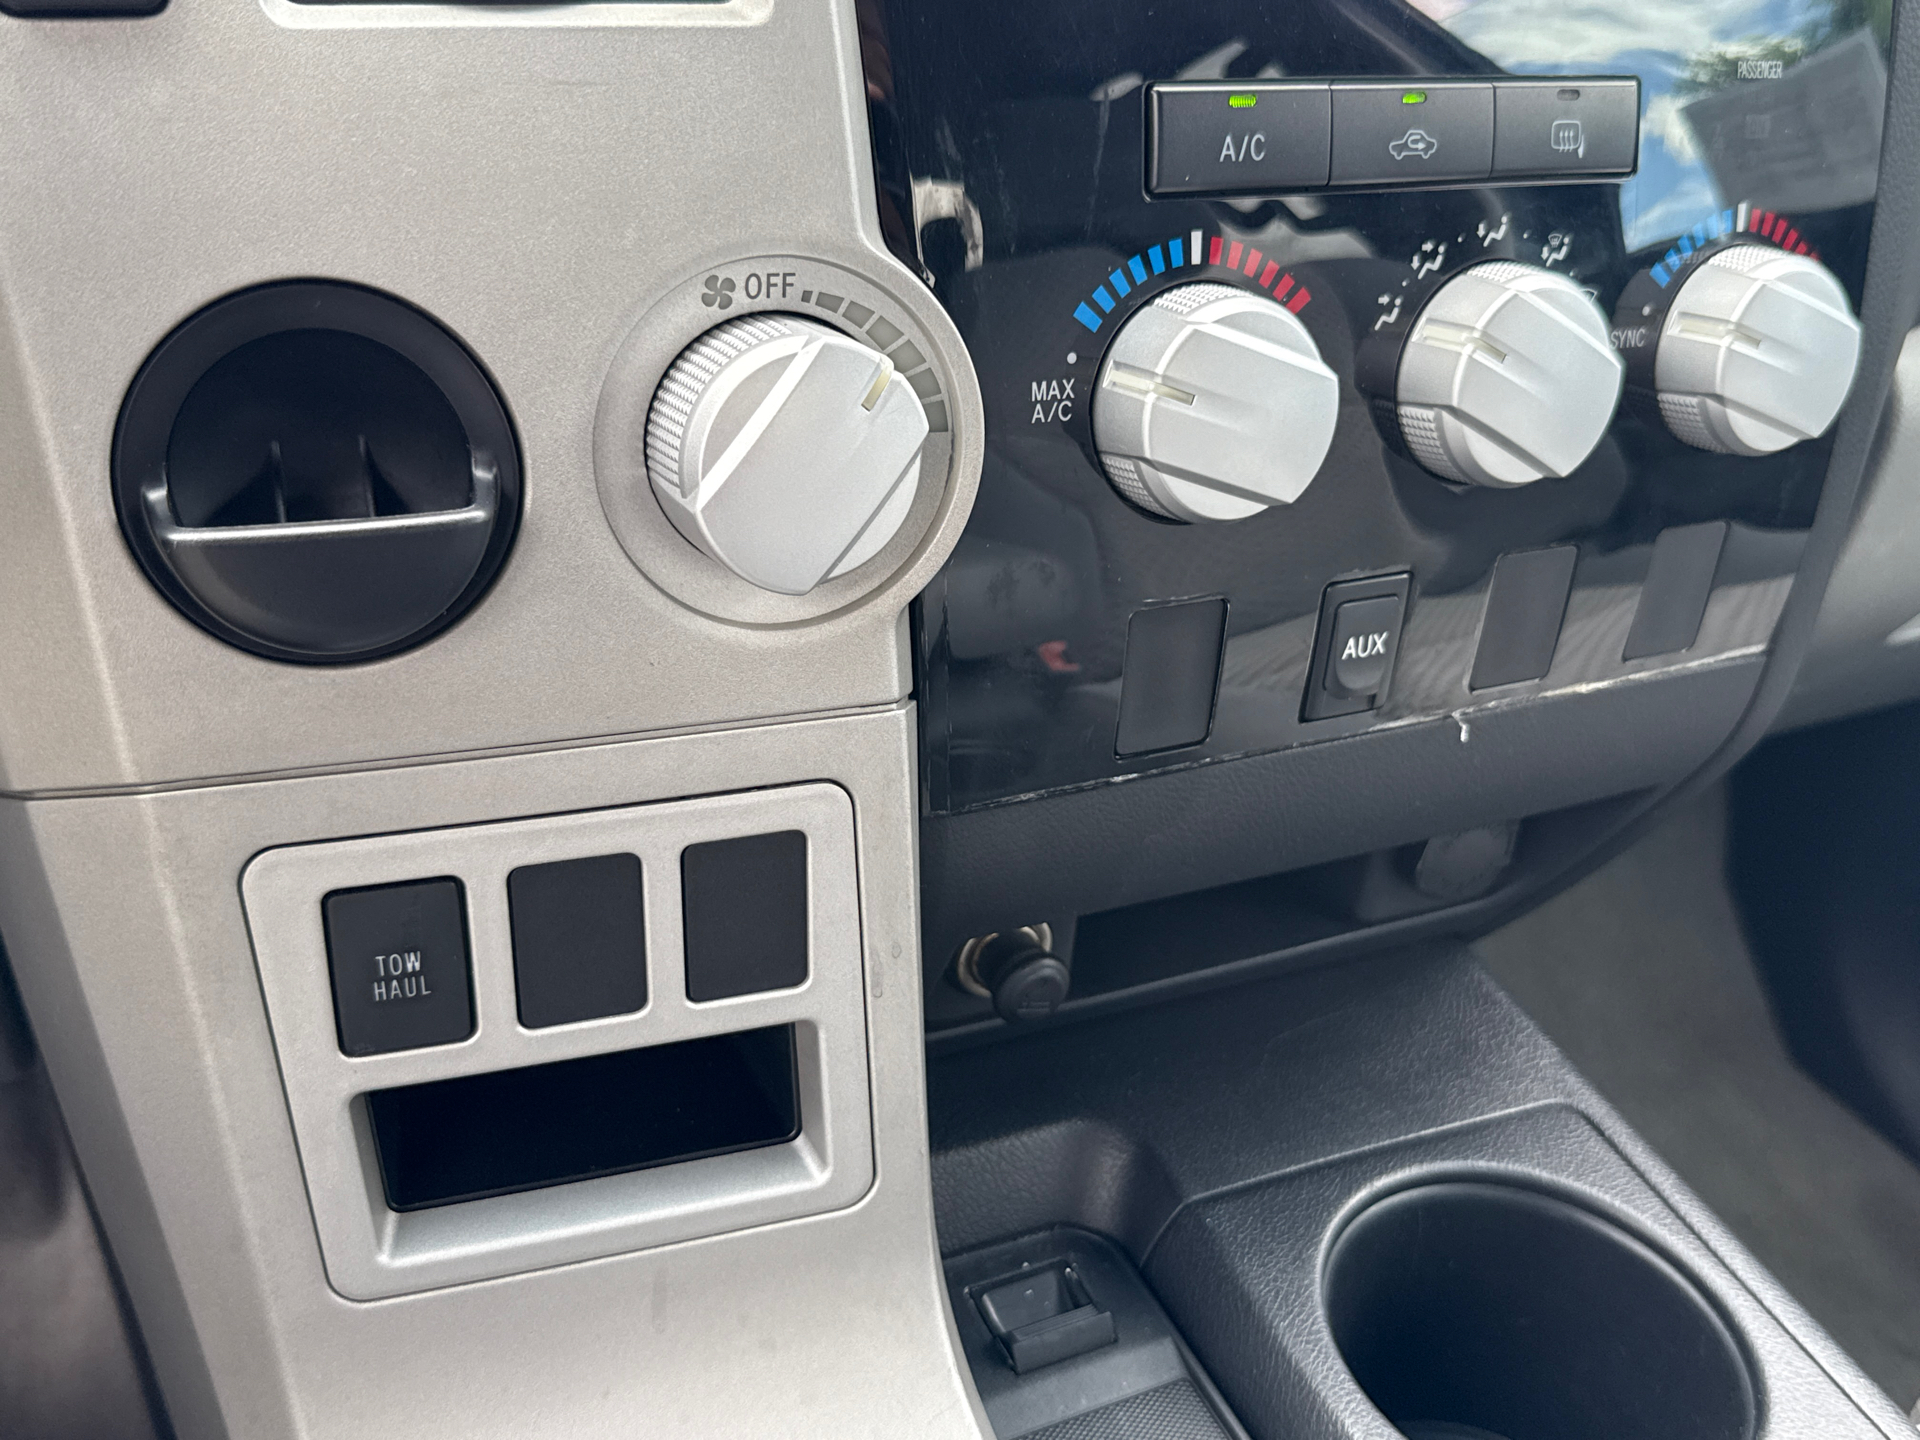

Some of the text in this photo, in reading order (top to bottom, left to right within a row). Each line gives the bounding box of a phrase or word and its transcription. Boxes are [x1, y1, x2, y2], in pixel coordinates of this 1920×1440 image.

[1737, 60, 1783, 79] PASSENGER
[1219, 132, 1266, 163] A/C
[744, 272, 797, 300] OFF
[1609, 327, 1646, 350] SYNC
[1031, 377, 1075, 402] MAX
[1031, 400, 1072, 424] A/C
[1341, 630, 1389, 660] AUX
[374, 950, 421, 977] TOW
[373, 975, 432, 1001] HAUL
